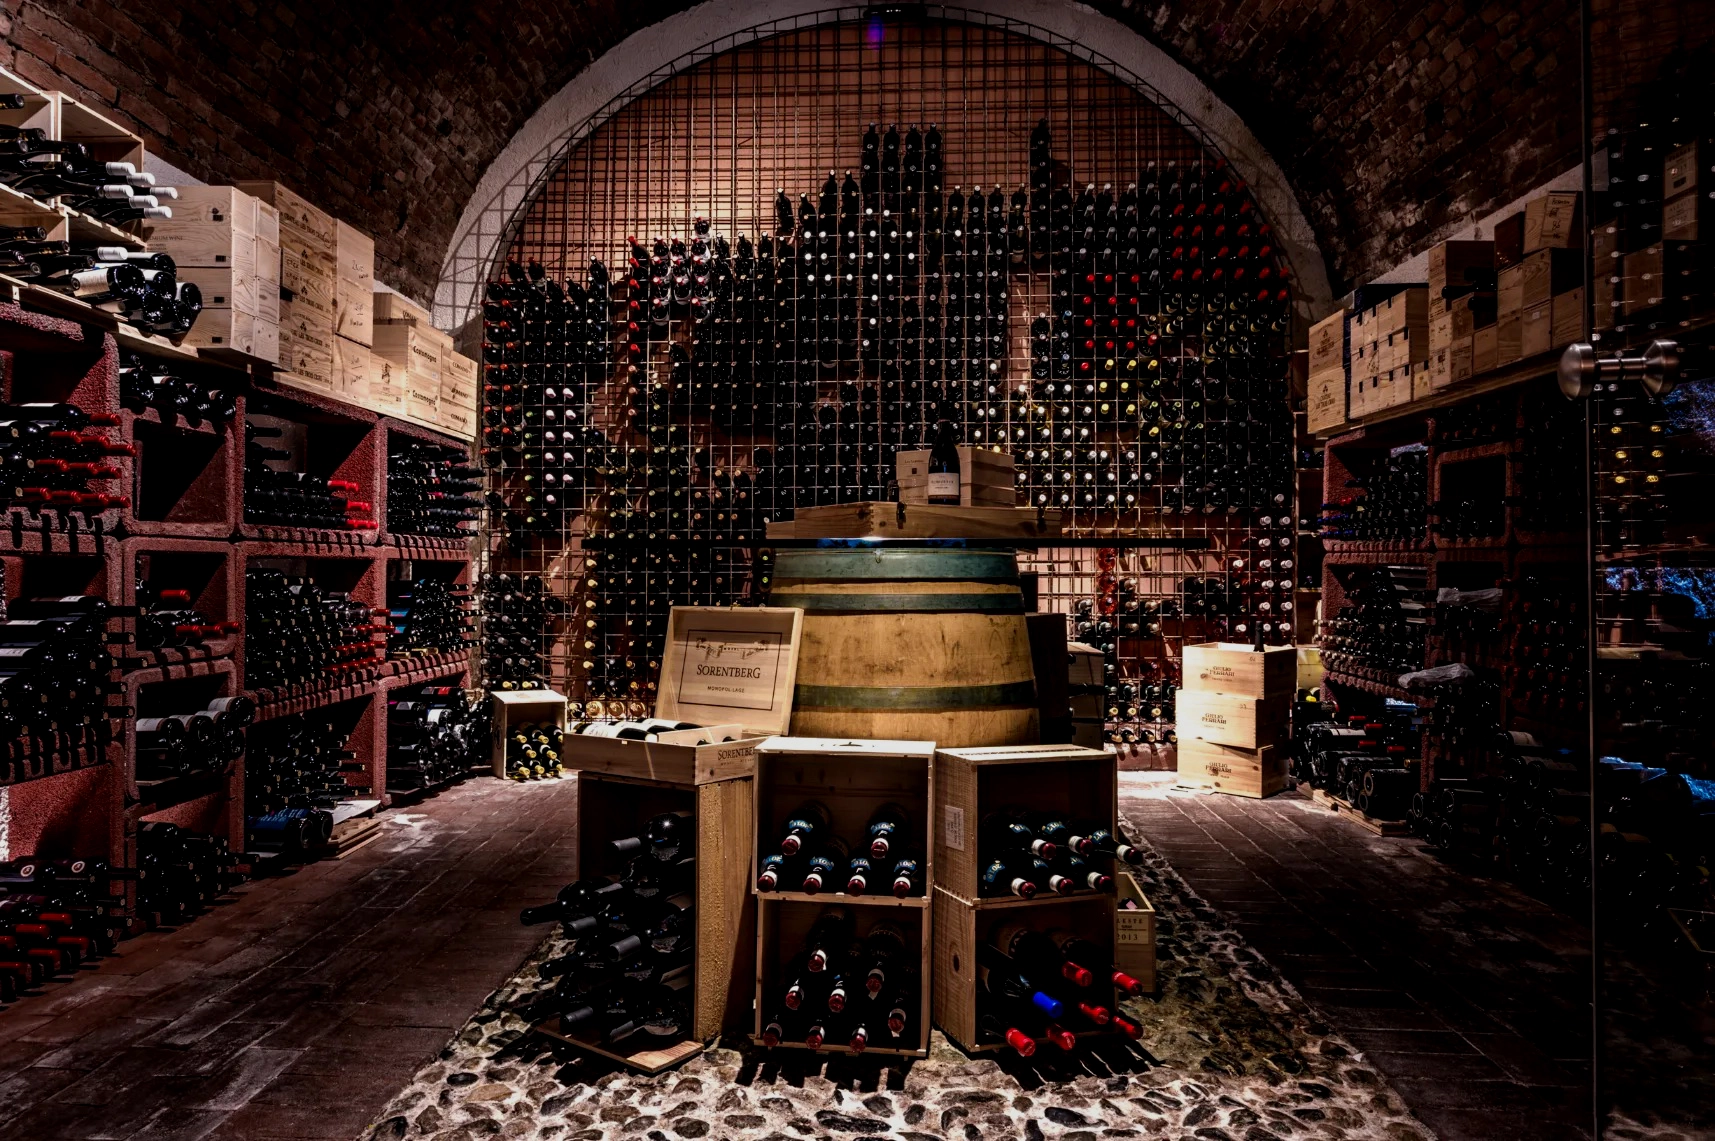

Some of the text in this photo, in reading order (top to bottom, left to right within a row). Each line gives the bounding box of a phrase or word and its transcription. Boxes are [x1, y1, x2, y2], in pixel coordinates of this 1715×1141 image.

[696, 664, 761, 679] SORENTBERG
[1209, 669, 1235, 677] FERRARI
[1204, 712, 1224, 720] GIULIO
[1201, 716, 1227, 725] FERRARI
[1116, 933, 1138, 941] 2013
